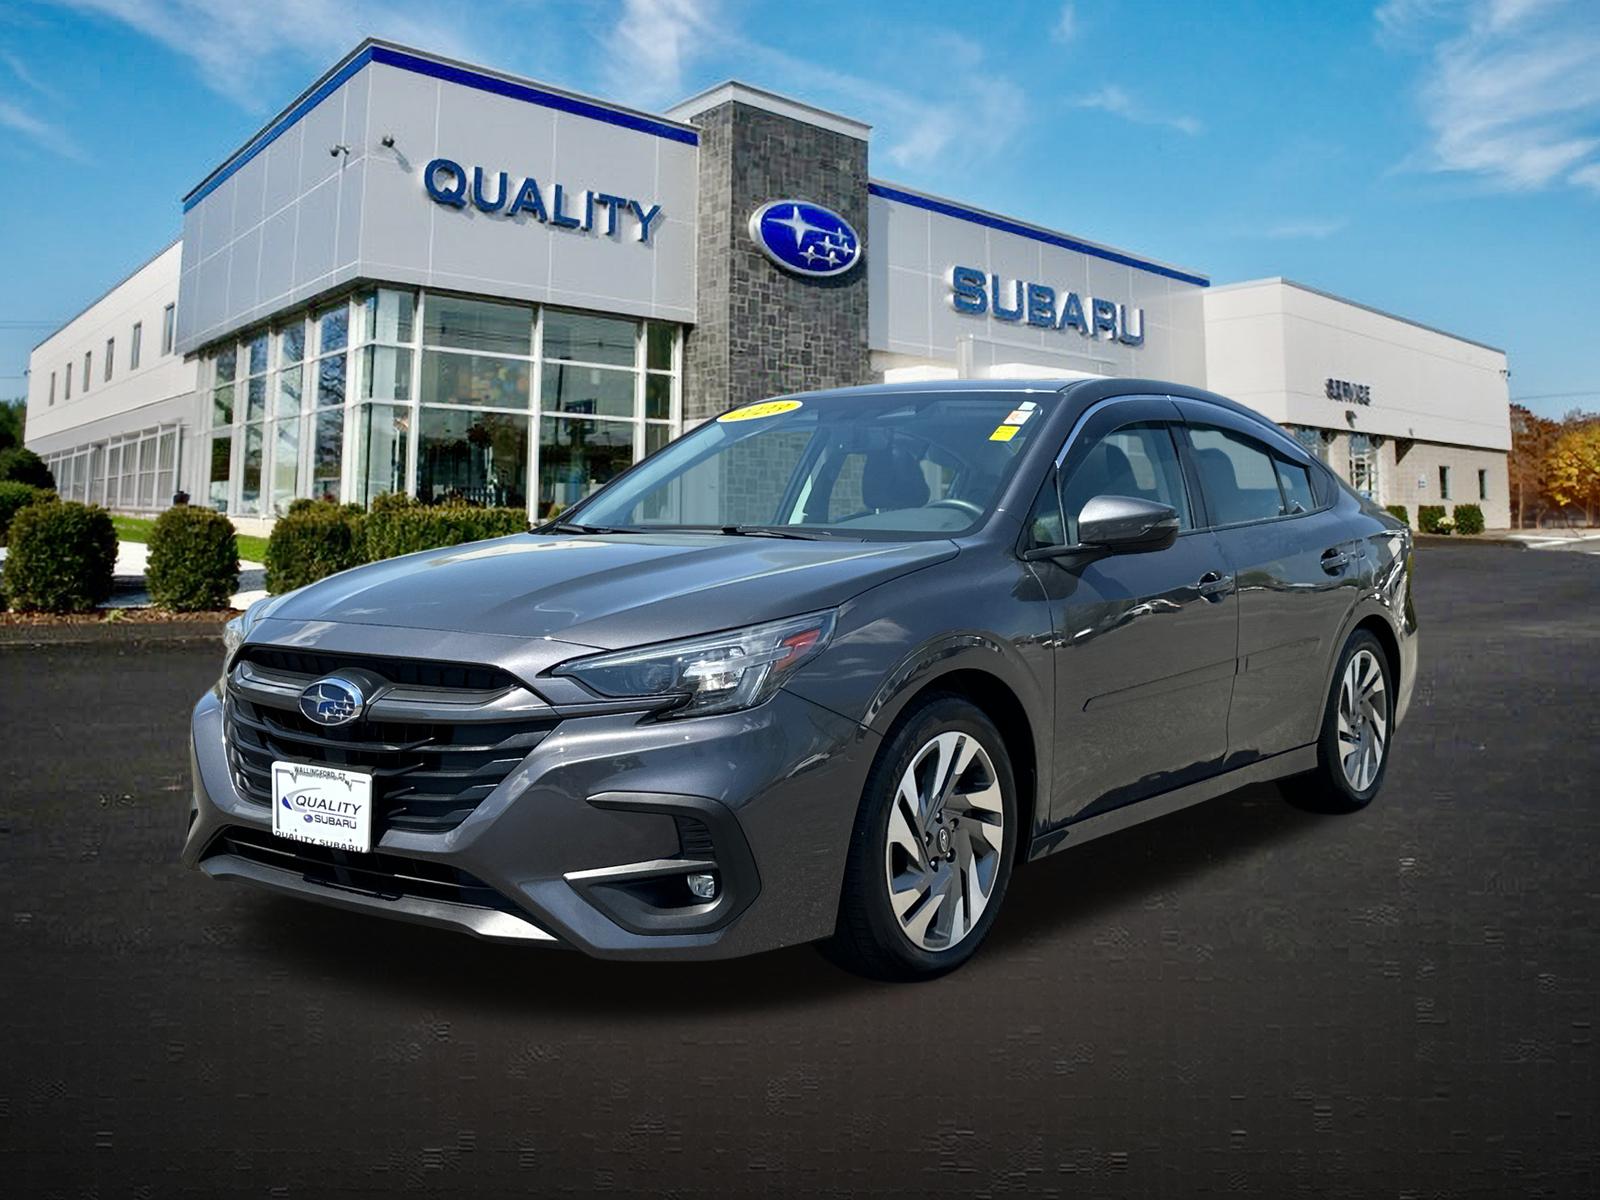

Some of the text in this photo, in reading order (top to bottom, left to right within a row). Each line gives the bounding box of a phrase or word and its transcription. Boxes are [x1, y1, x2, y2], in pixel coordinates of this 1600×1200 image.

[423, 157, 661, 243] QUALITY
[951, 265, 1144, 346] SUBARU
[295, 795, 362, 815] QUALITY
[314, 814, 357, 829] SUBARU
[275, 830, 364, 853] QUALITY SUBARU
